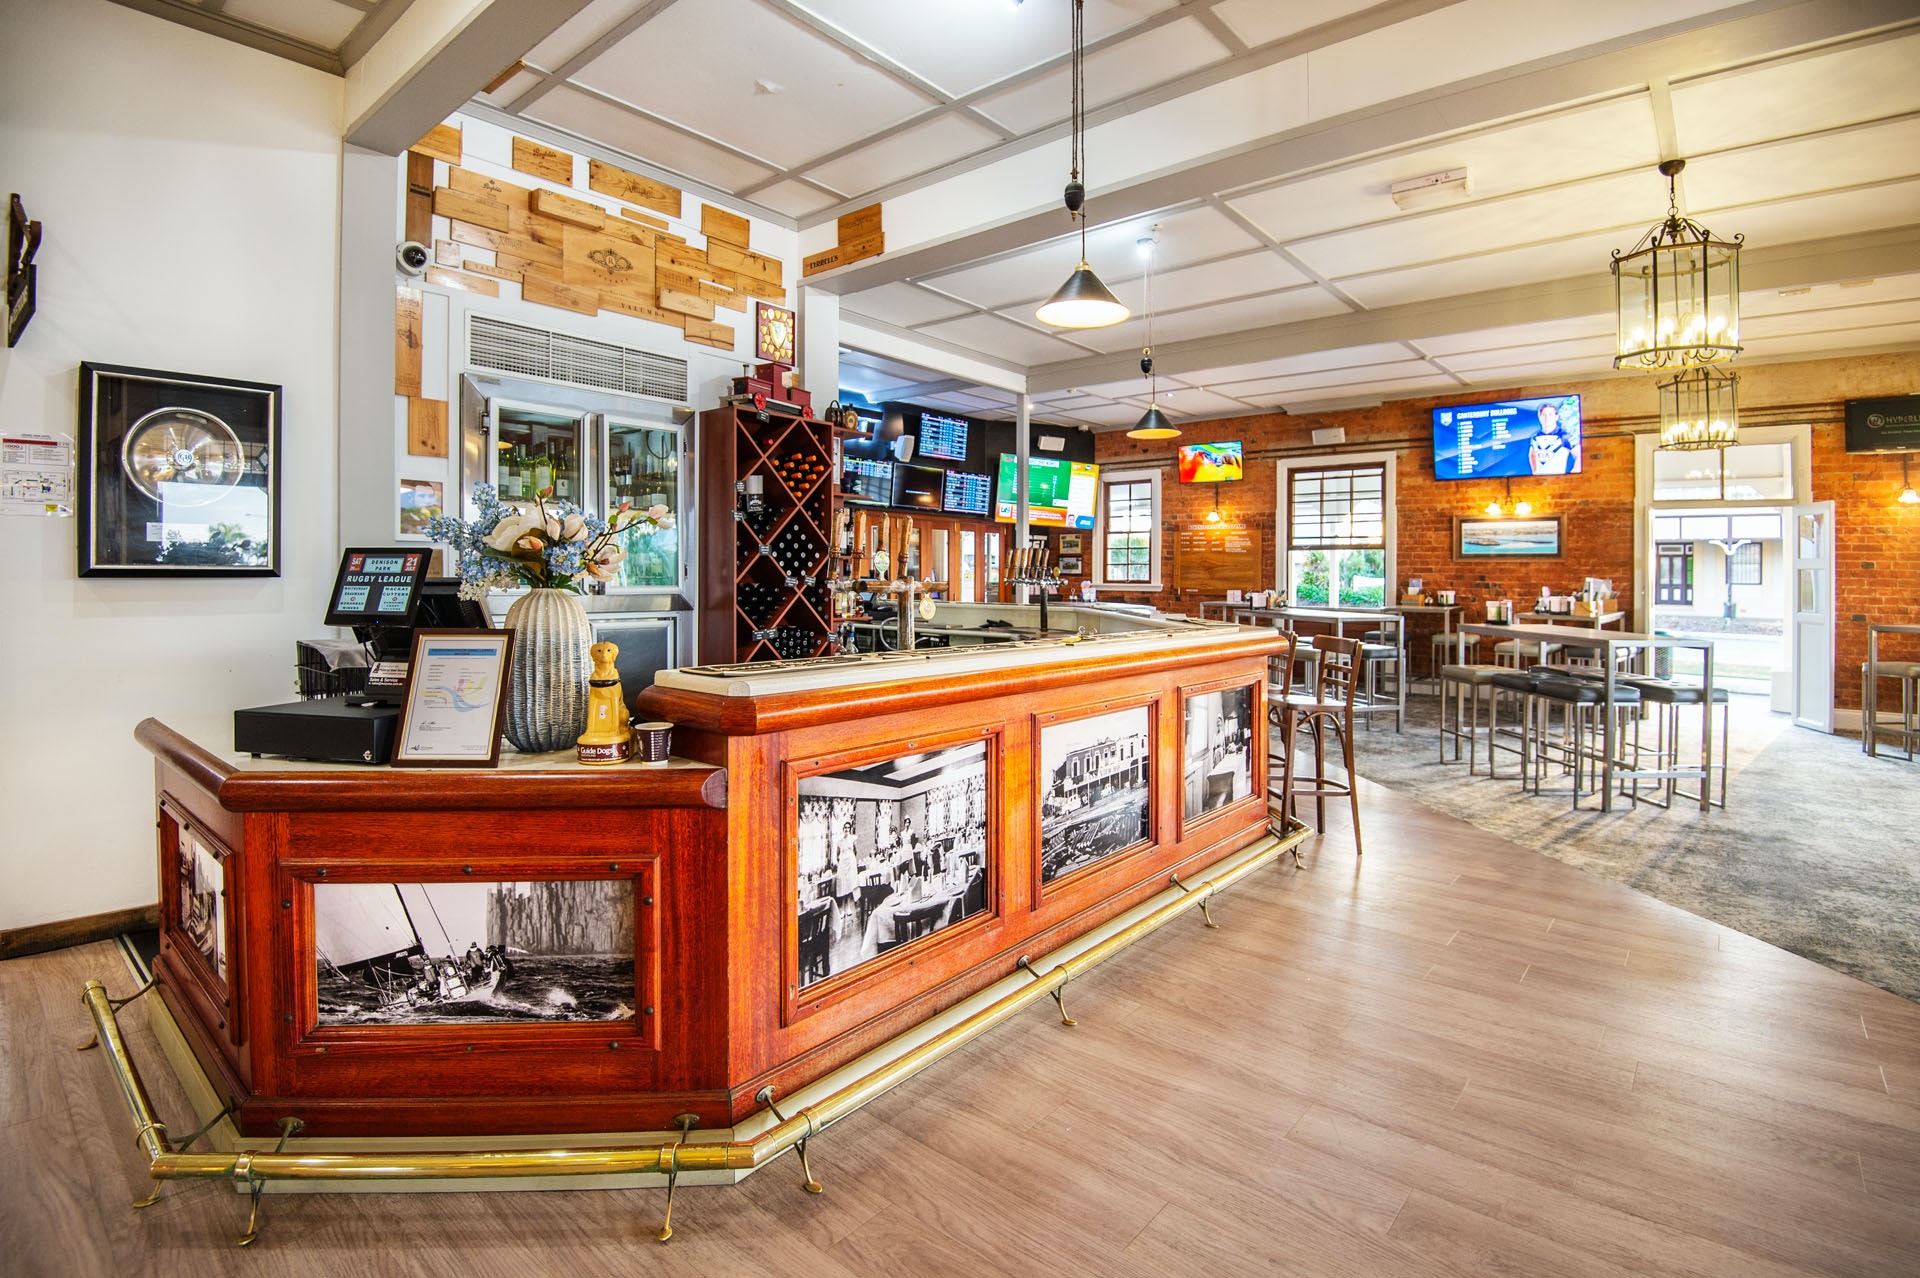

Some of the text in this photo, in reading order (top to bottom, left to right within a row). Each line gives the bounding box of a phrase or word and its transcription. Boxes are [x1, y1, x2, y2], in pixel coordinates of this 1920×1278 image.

[620, 302, 665, 318] YALUMBA
[351, 557, 363, 565] SAT
[406, 557, 418, 567] 21
[346, 575, 412, 583] RUGBY LEAGUE
